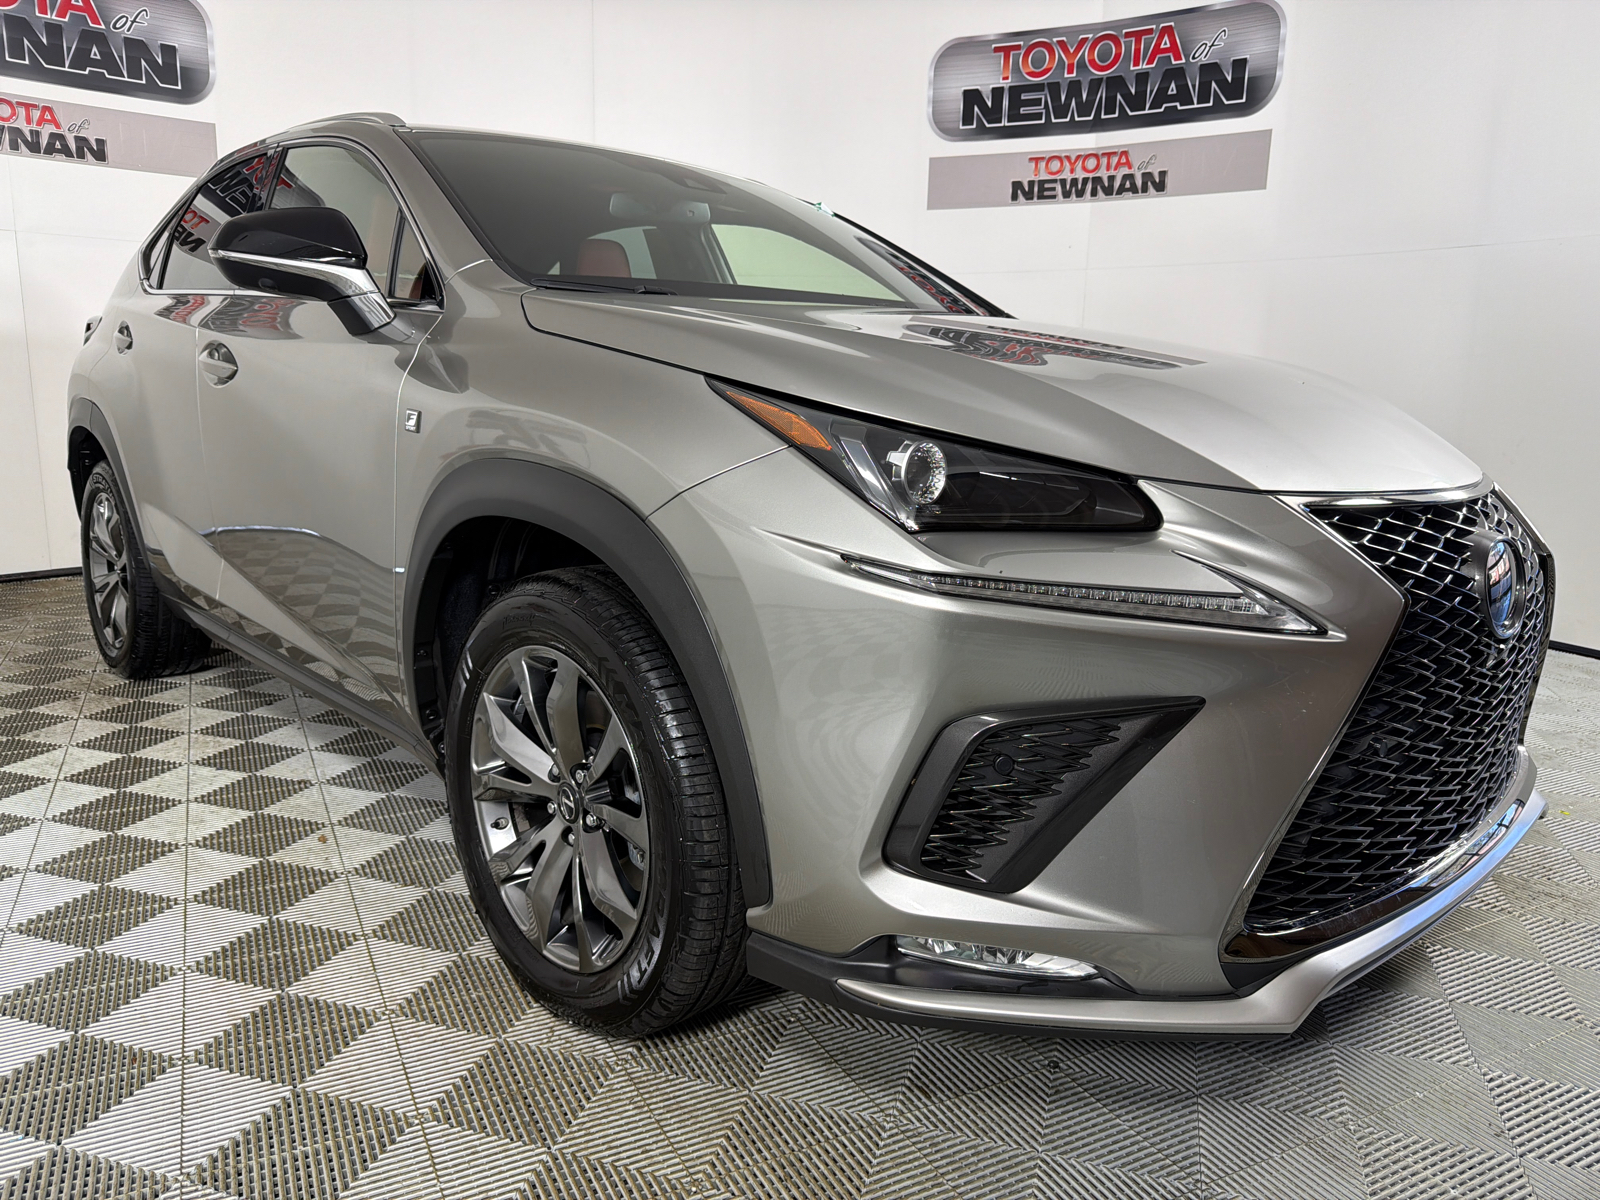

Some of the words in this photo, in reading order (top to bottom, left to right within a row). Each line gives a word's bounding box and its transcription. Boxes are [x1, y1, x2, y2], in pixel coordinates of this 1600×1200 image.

[110, 7, 149, 34] of
[3, 12, 181, 89] NAN
[992, 23, 1184, 82] TOYOTA
[1189, 28, 1227, 62] of
[960, 56, 1249, 129] NEWNAN
[0, 124, 108, 163] NAN
[67, 118, 90, 133] of
[1028, 149, 1134, 178] TOYOTA
[1137, 153, 1158, 172] of
[1010, 169, 1169, 203] NEWNAN
